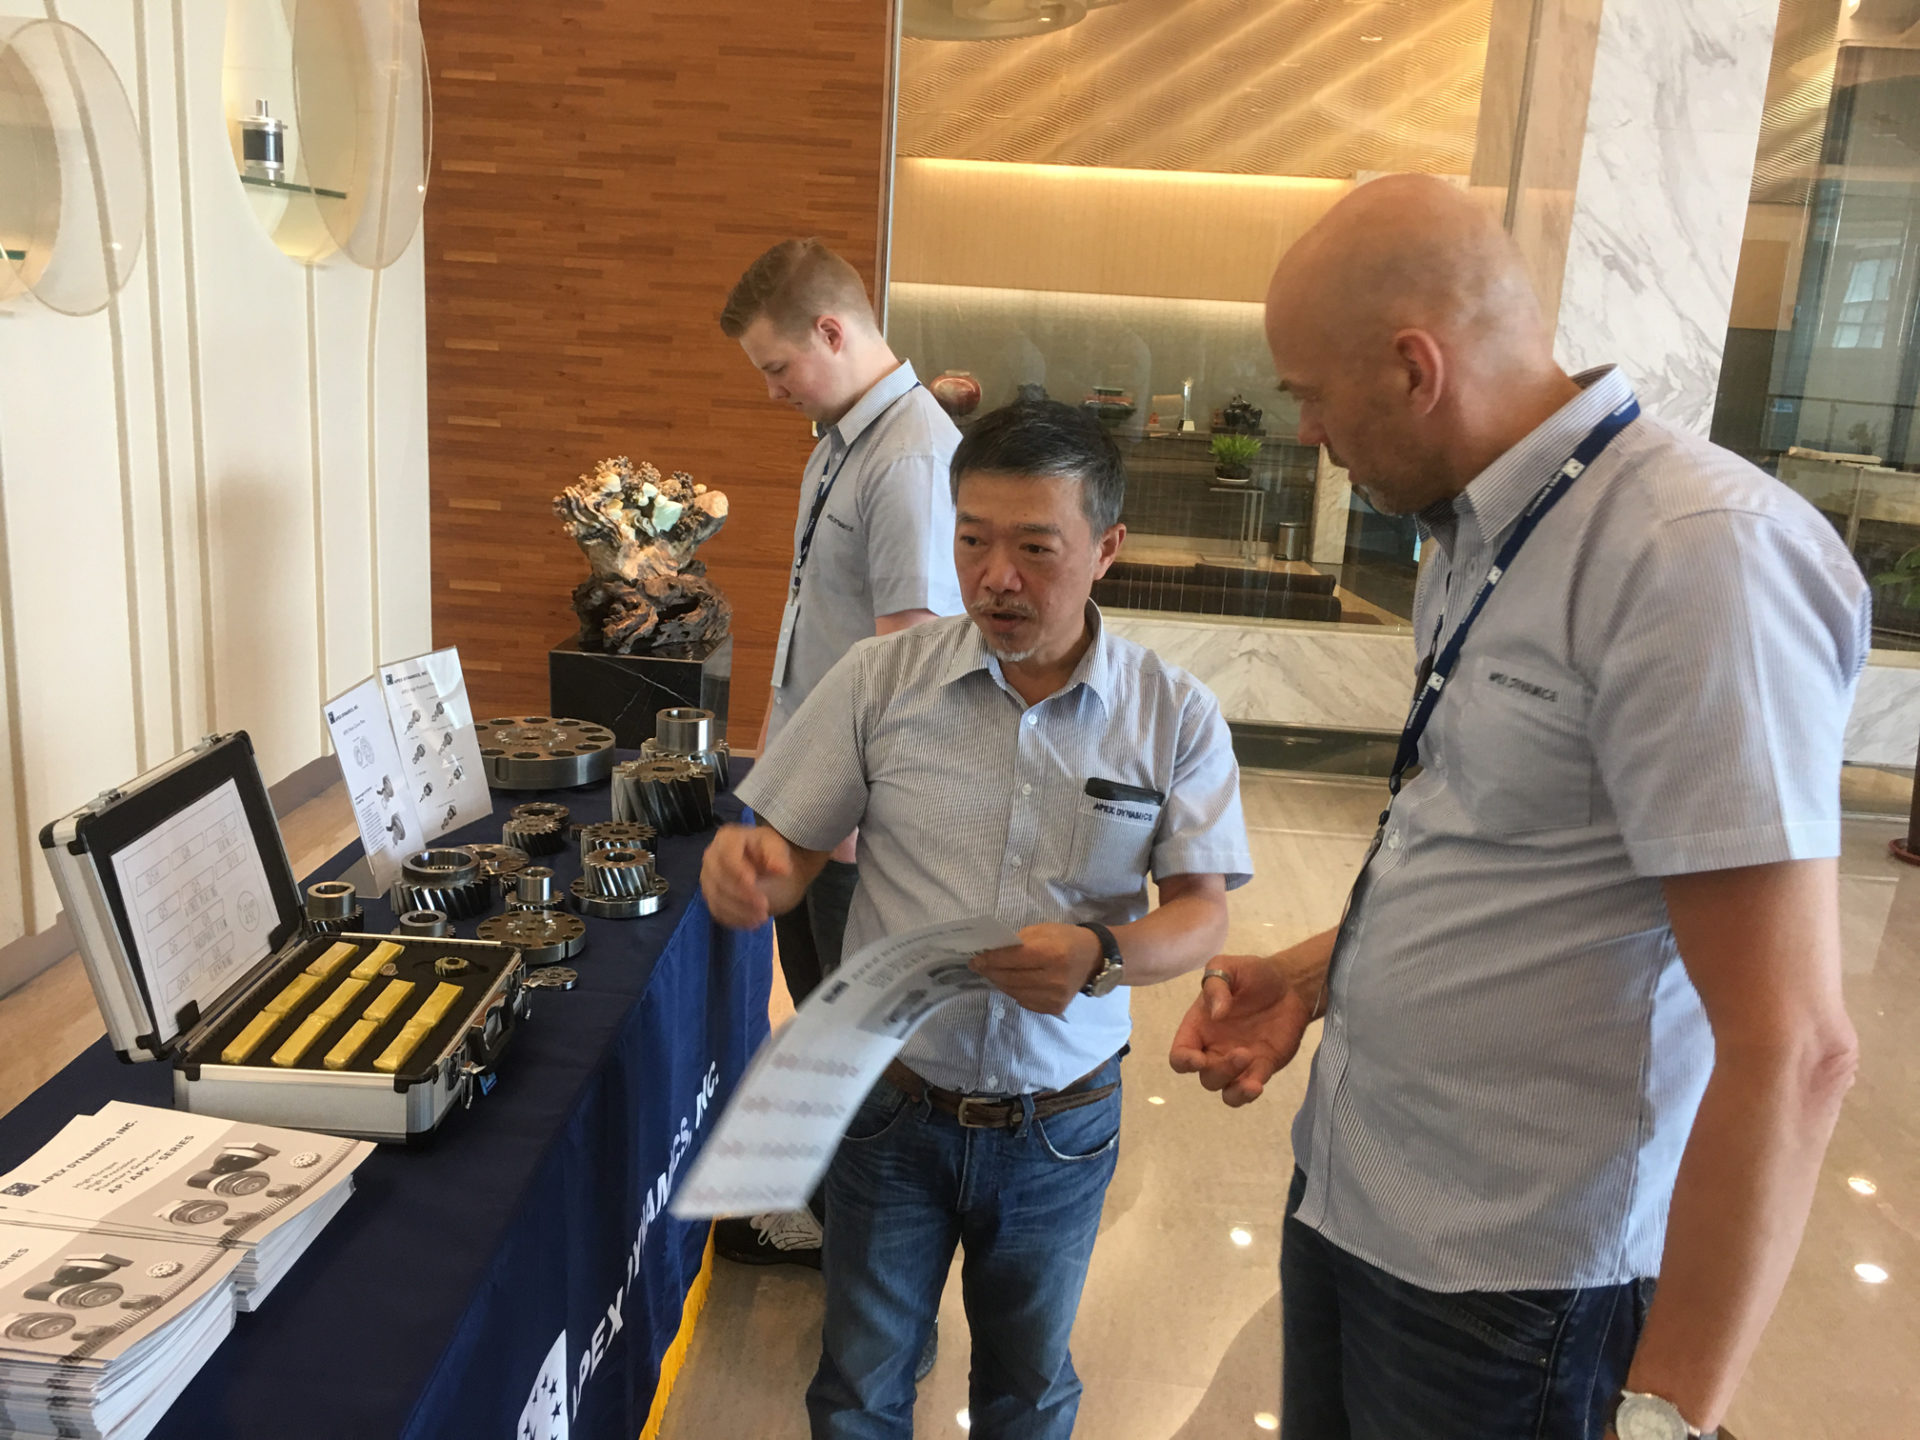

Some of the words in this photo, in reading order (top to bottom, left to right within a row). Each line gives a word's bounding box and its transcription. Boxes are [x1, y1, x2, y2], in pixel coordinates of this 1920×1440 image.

[1093, 802, 1115, 815] APEX
[158, 1135, 194, 1161] SERIES
[41, 1168, 70, 1184] APEX
[573, 1285, 624, 1423] PEX
[695, 1060, 719, 1129] NC.
